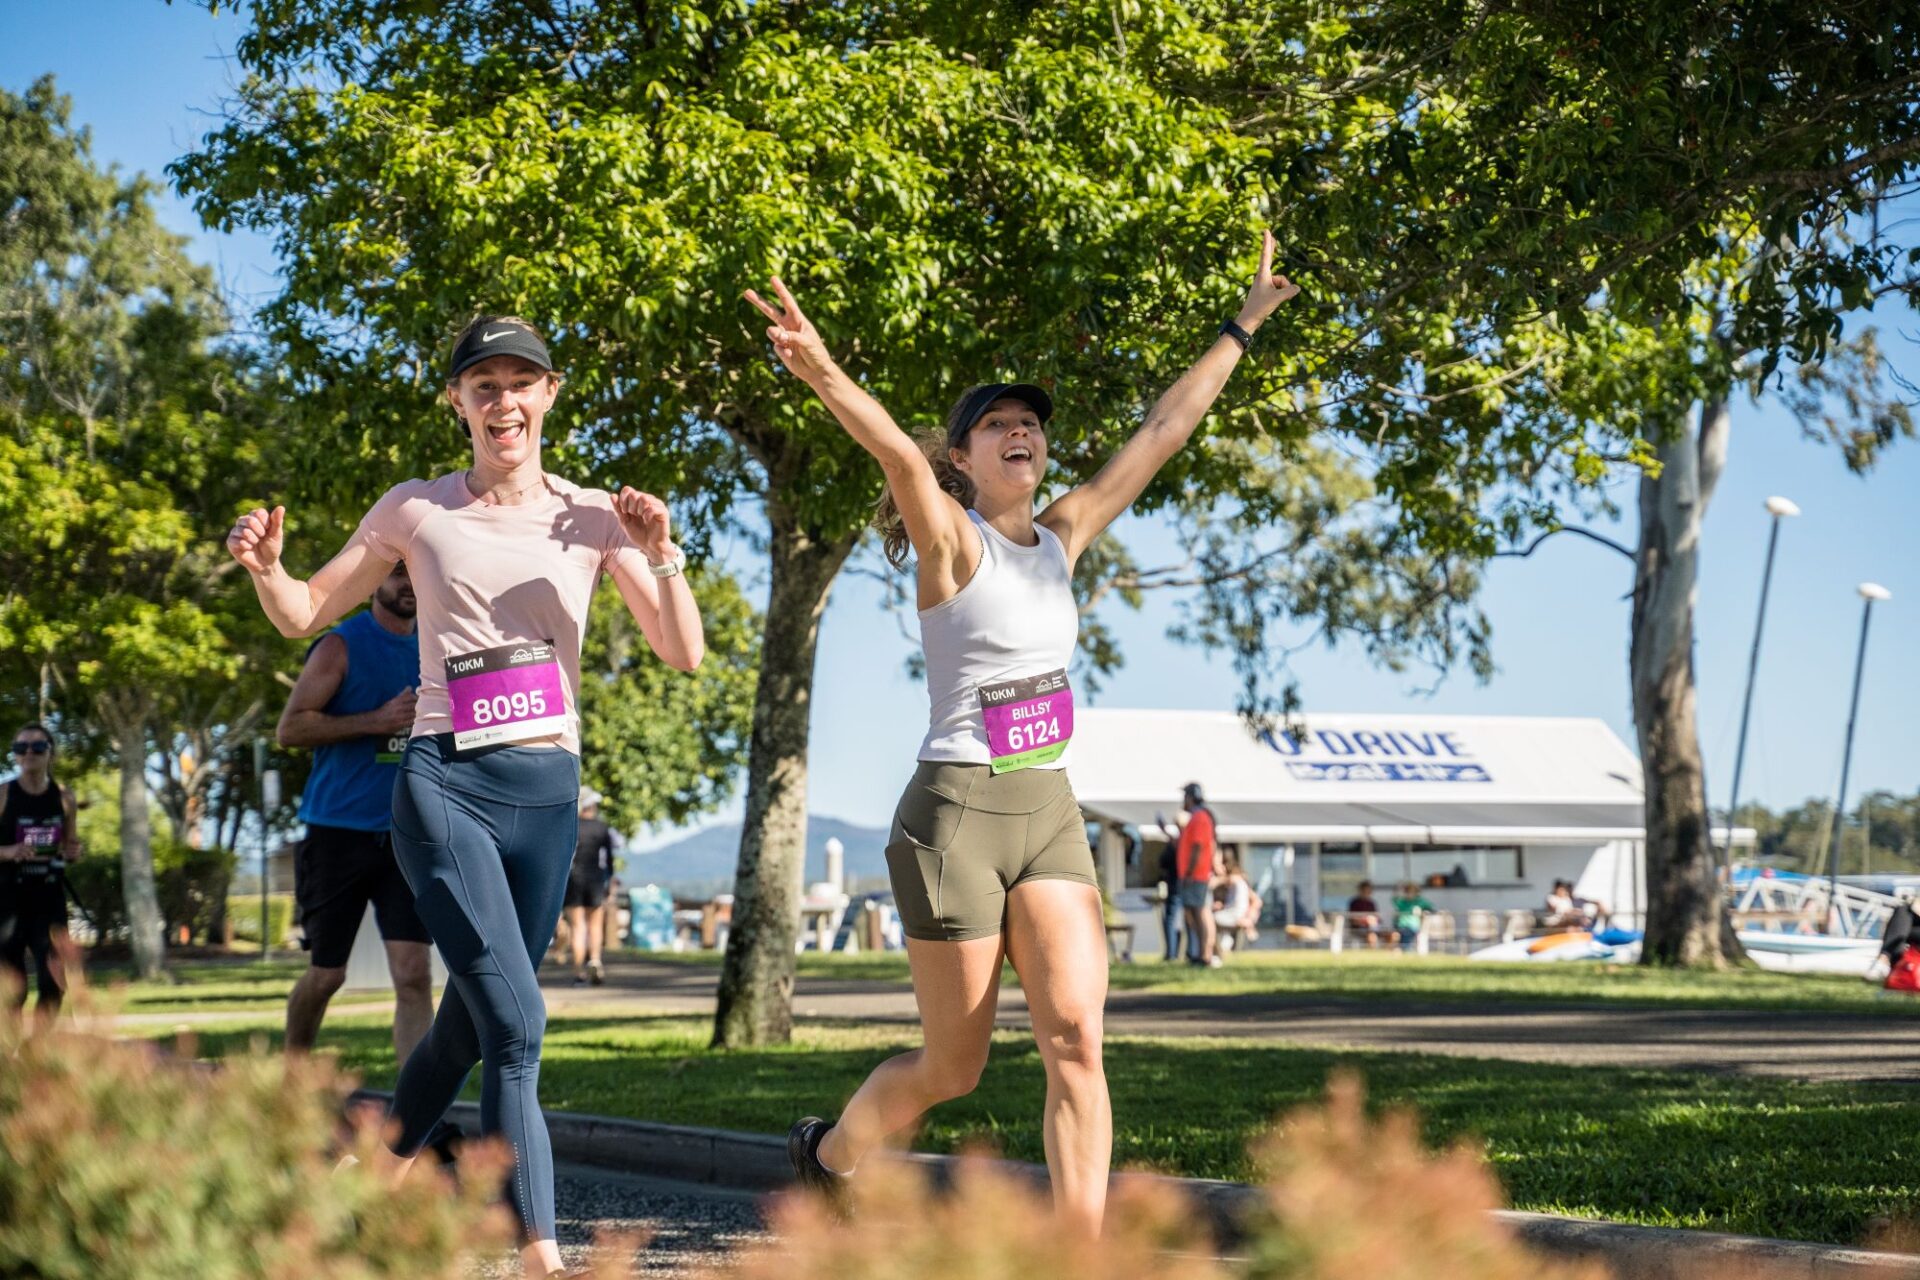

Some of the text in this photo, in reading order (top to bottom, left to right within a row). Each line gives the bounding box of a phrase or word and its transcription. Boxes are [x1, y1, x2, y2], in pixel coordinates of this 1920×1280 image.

[452, 656, 484, 673] 10KM
[985, 687, 1016, 702] 10KM
[472, 689, 547, 724] 8095
[1012, 700, 1052, 720] BILLSY
[1008, 716, 1060, 750] 6124
[1315, 731, 1473, 756] DRIVE
